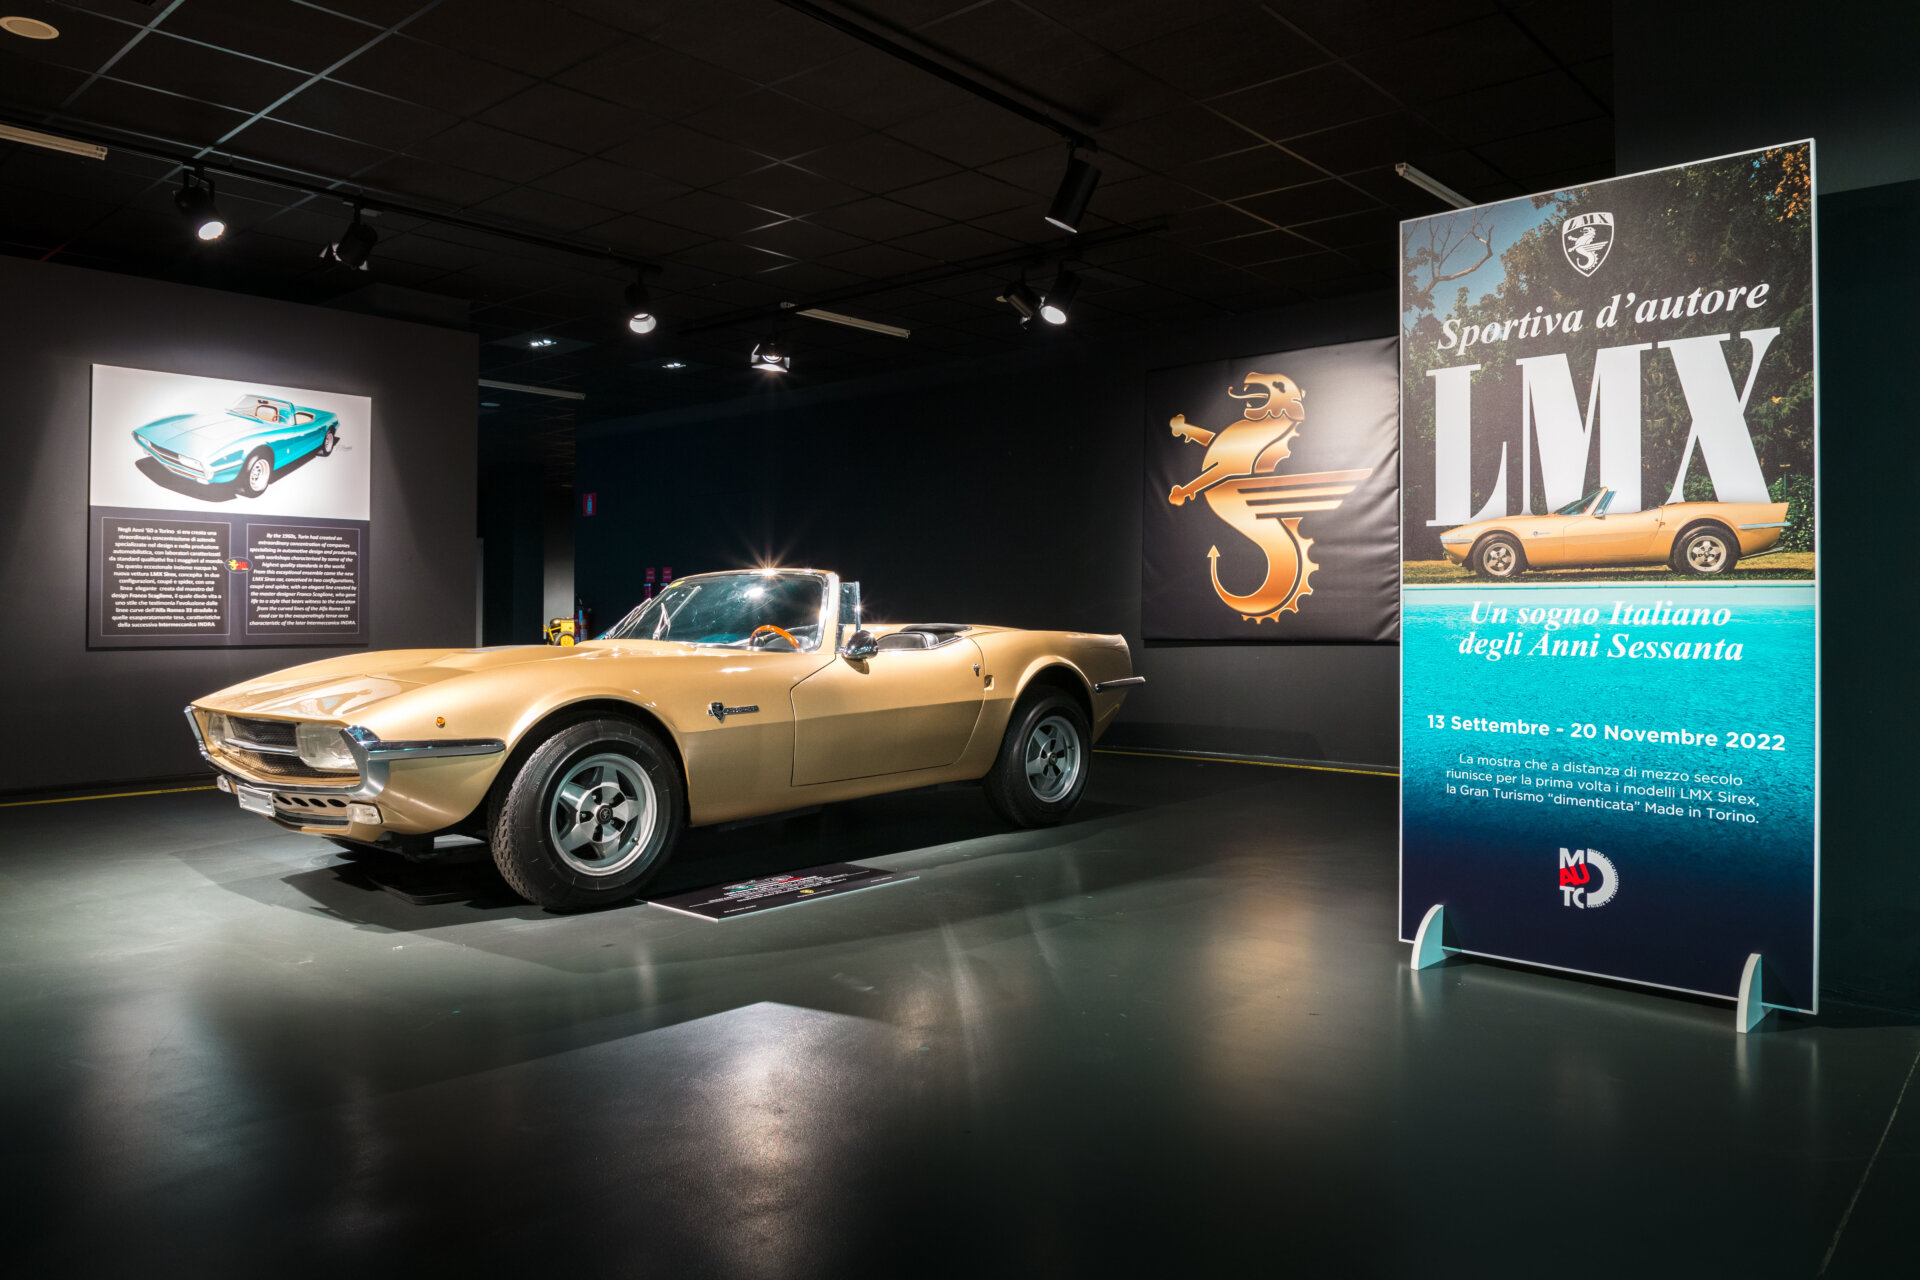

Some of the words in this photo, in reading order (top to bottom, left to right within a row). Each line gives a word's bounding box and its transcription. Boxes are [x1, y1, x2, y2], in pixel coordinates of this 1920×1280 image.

[1567, 213, 1609, 231] LMX
[1437, 306, 1583, 355] Sportiva
[1595, 283, 1770, 329] d’autore
[1425, 327, 1781, 527] LMX
[1470, 600, 1507, 625] Un
[1516, 604, 1599, 630] sogno
[1609, 600, 1731, 626] Italiano
[1458, 632, 1522, 661] degli
[1529, 633, 1599, 657] Anni
[1607, 633, 1743, 661] Sessanta
[1427, 714, 1444, 729] 13
[1451, 715, 1549, 736] Settembre
[1570, 722, 1596, 739] 20
[1604, 724, 1717, 746] Novembre
[1725, 731, 1785, 751] 2022
[1459, 753, 1473, 764] La
[1477, 756, 1520, 768] mostra
[1524, 758, 1547, 770] che
[1563, 762, 1619, 776] distanza
[1624, 765, 1636, 777] di
[1641, 769, 1689, 782] mezzo
[1694, 773, 1742, 786] secolo
[1446, 770, 1492, 781] riunisce
[1496, 774, 1516, 784] per
[1521, 774, 1531, 785] la
[1535, 777, 1573, 789] prima
[1577, 779, 1611, 792] volta
[1623, 782, 1675, 798] modelli
[1680, 787, 1712, 801] LMX
[1717, 790, 1760, 806] Sirex,
[1446, 783, 1456, 794] la
[1459, 784, 1488, 797] Gran
[1493, 789, 1544, 802] Turismo
[1547, 792, 1640, 812] “dimenticata”
[1644, 802, 1683, 816] Made
[1688, 808, 1701, 818] in
[1706, 807, 1758, 823] Torino.
